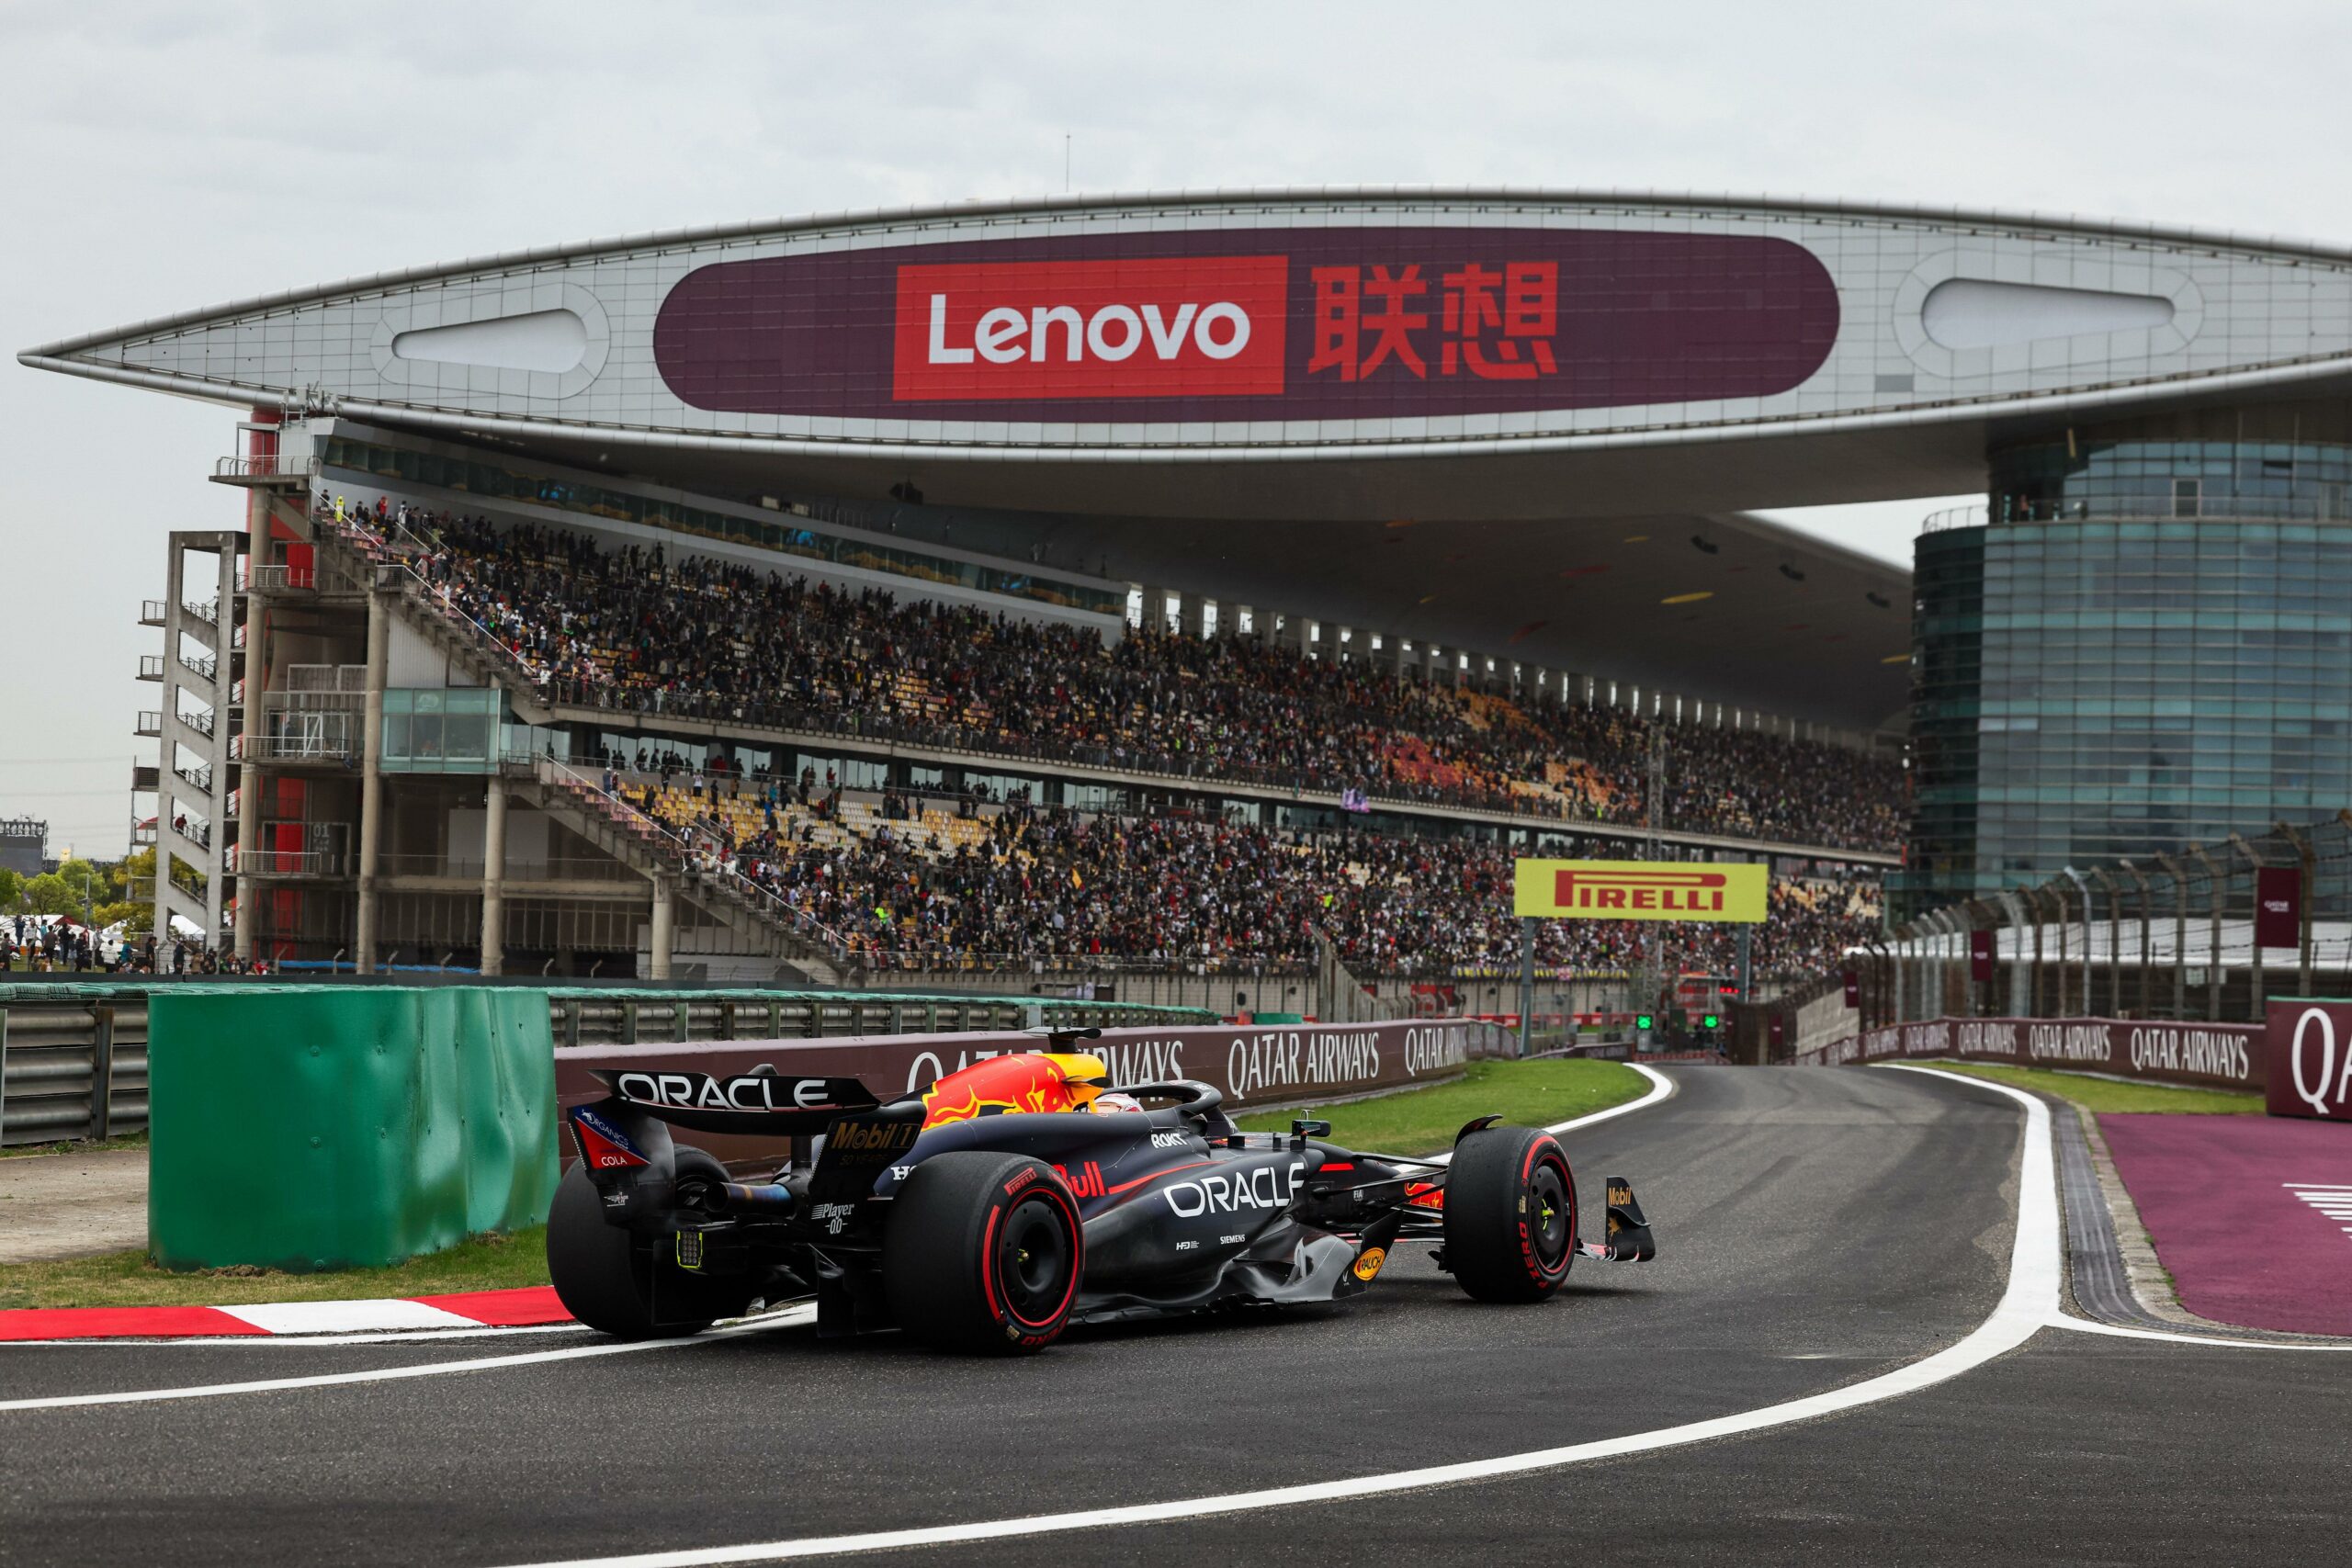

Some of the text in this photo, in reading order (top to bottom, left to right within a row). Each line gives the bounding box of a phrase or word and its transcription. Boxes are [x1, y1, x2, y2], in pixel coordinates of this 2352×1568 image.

[929, 294, 1250, 364] Lenovo
[1308, 262, 1558, 382] 联想
[1555, 869, 1727, 912] PIRELLI
[1405, 1027, 1443, 1077] QATAR
[2029, 1024, 2111, 1061] QATAR AIRWAYS
[2131, 1027, 2249, 1080] QATAR AIRWAYS
[1227, 1031, 1379, 1100] QATAR AIRWAYS
[618, 1073, 829, 1110] ORACLE
[831, 1122, 898, 1149] Mobil
[1150, 1133, 1188, 1149] ROKT
[601, 1156, 628, 1167] COLA
[1003, 1166, 1037, 1197] PIRELLI
[1163, 1162, 1305, 1218] ORACLE
[1609, 1186, 1632, 1205] Mobil
[821, 1202, 855, 1219] Player
[1220, 1234, 1246, 1245] SIEMENS
[1519, 1221, 1541, 1280] ZERO
[1360, 1255, 1382, 1271] RAUCH
